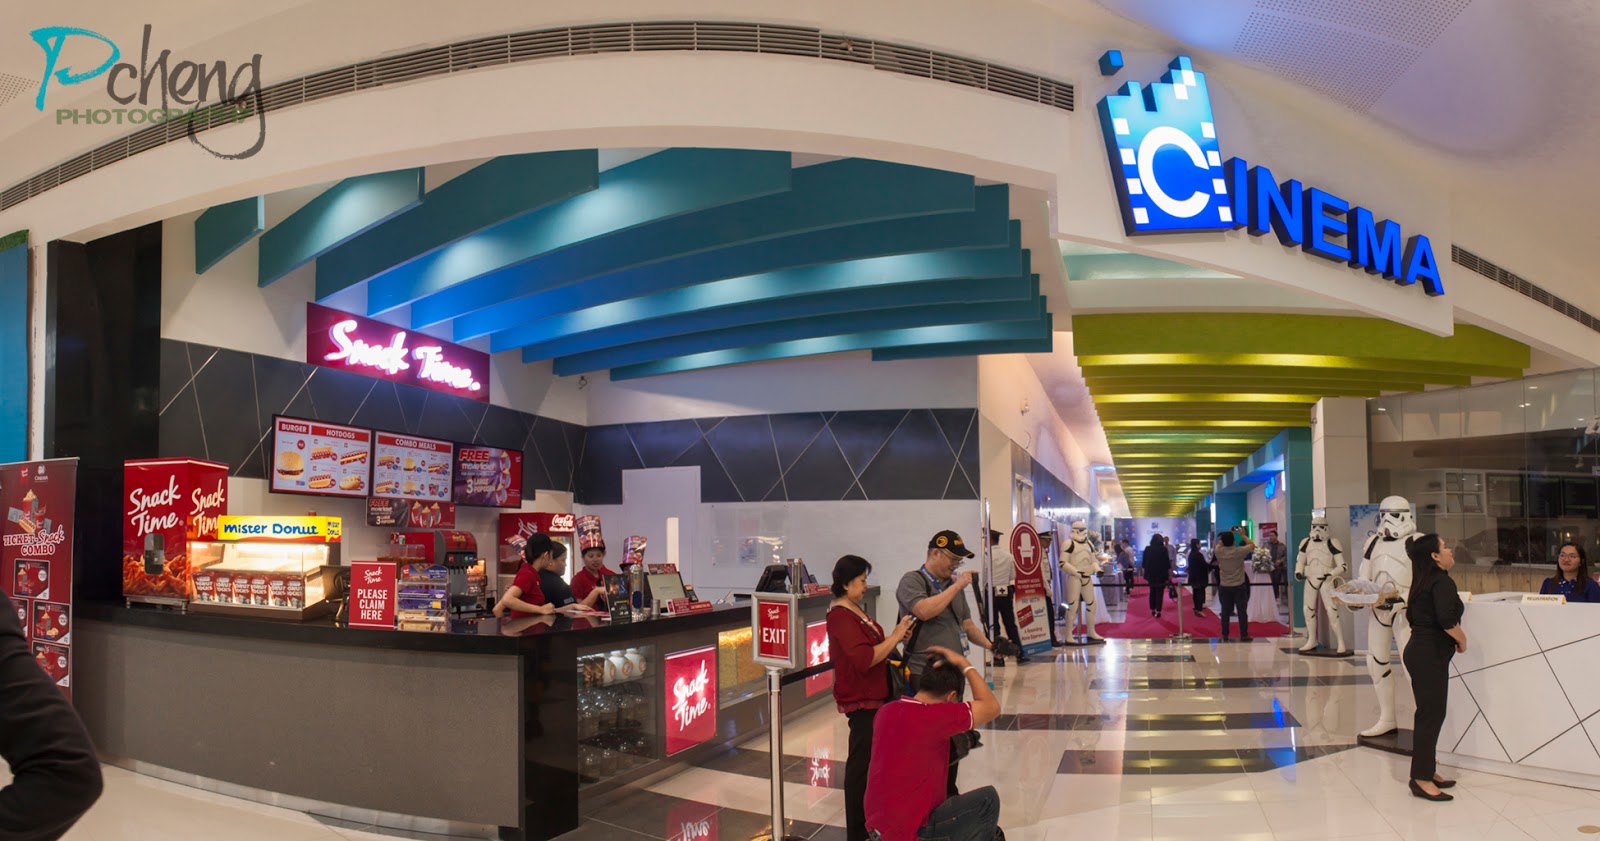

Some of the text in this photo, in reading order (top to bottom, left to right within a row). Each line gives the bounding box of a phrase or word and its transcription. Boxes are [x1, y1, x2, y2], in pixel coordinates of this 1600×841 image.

[1137, 126, 1445, 297] CINEMA
[324, 319, 410, 375] Snack
[281, 423, 307, 433] BURGER
[326, 429, 355, 439] HOTDOGS
[395, 438, 436, 450] COMBO MEALS
[459, 449, 489, 462] FREE
[466, 478, 474, 494] 3
[127, 474, 181, 515] Snack
[190, 478, 225, 515] Snack
[131, 510, 179, 537] Time
[193, 511, 219, 538] Tim
[376, 515, 381, 525] 3
[272, 523, 319, 535] Donut
[21, 544, 55, 556] COMBO
[364, 566, 382, 577] Snack
[357, 588, 388, 600] PLEASE
[359, 599, 385, 610] CLAIM
[360, 609, 383, 621] HERE
[762, 626, 787, 645] EXIT
[671, 659, 710, 710] Snack
[674, 697, 708, 732] Time
